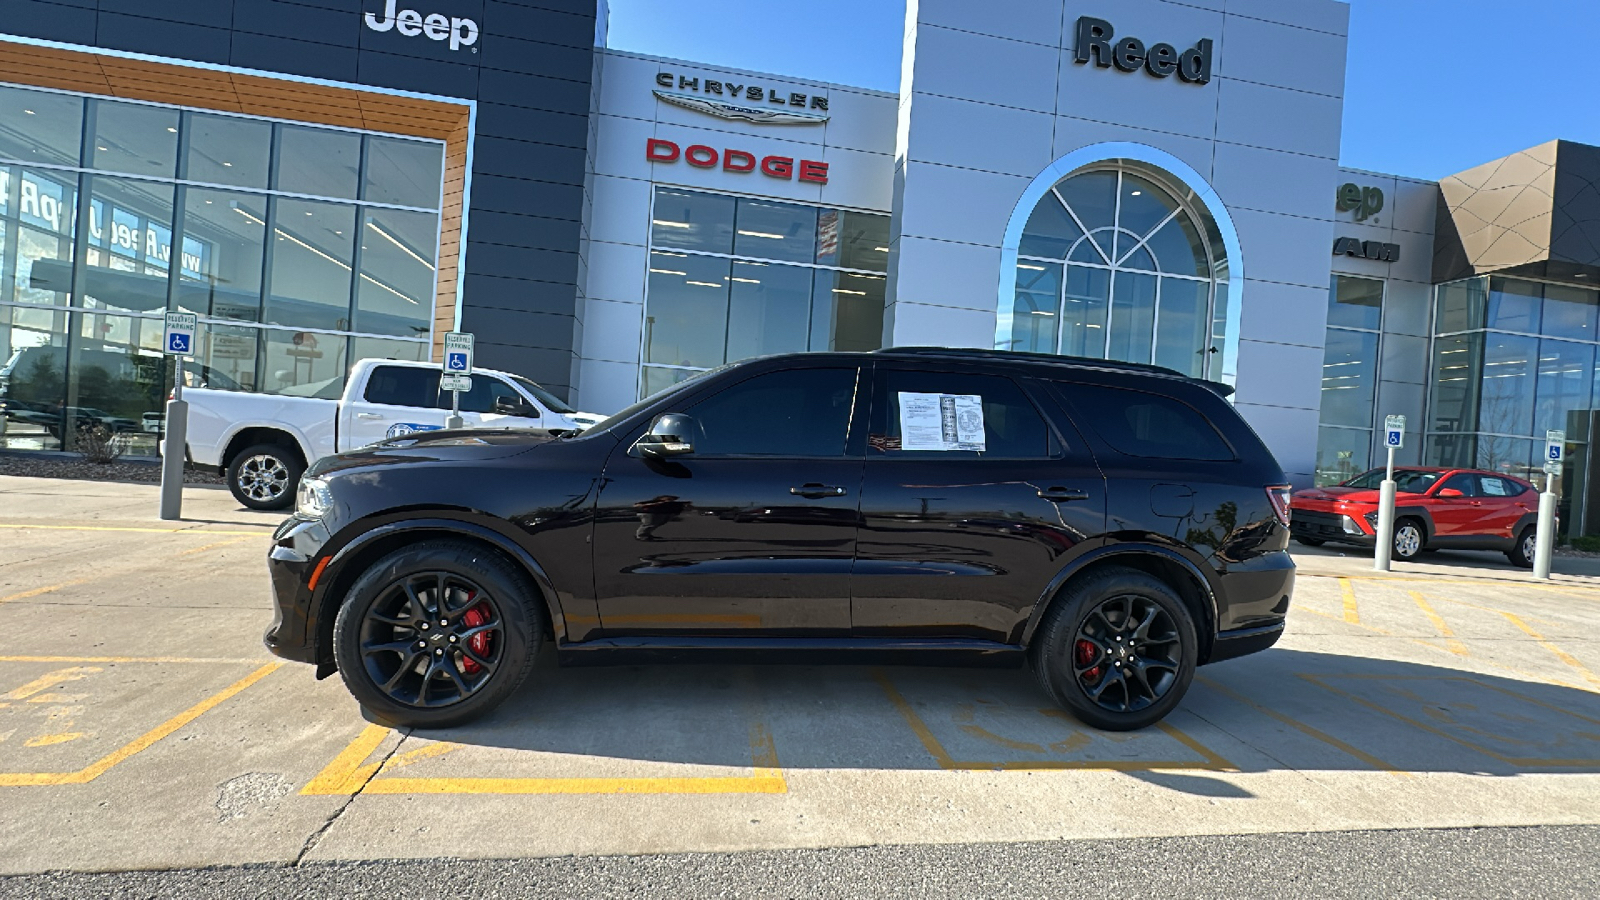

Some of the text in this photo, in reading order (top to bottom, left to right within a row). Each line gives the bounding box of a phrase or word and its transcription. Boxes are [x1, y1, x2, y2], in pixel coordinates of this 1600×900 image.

[364, 0, 479, 51] Jeep
[1074, 15, 1213, 85] Reed
[656, 72, 829, 110] CHRYSLER
[646, 138, 829, 184] DODGE
[1336, 182, 1384, 223] ep
[1332, 236, 1400, 262] AM
[167, 315, 194, 324] RESERVED
[448, 335, 471, 343] RESERVED
